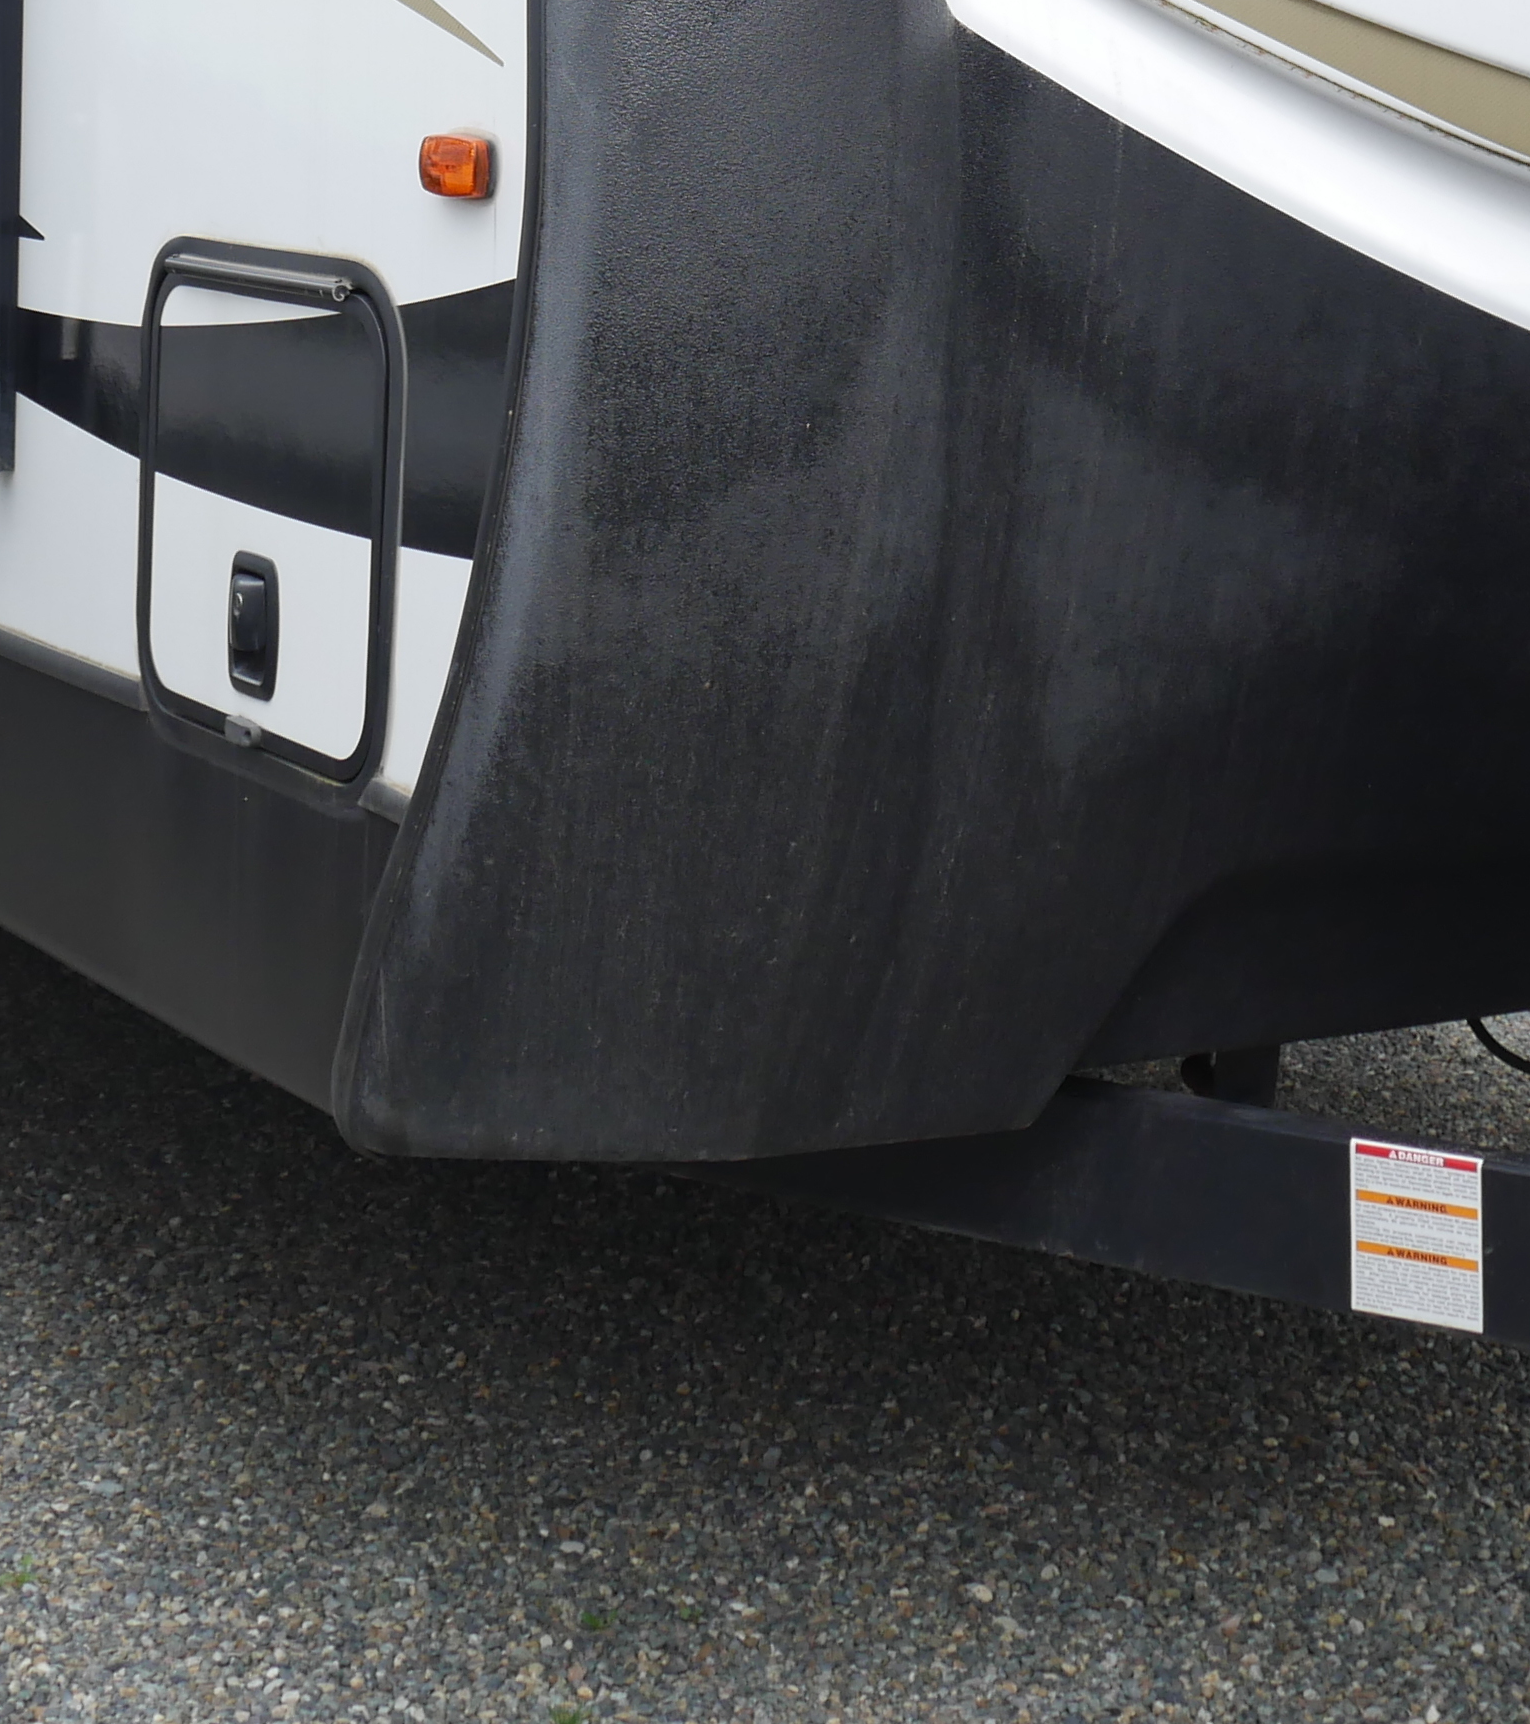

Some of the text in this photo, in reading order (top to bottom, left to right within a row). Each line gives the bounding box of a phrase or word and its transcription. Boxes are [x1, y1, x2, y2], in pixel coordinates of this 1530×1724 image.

[1397, 1150, 1445, 1167] DANGER
[1396, 1197, 1448, 1214] WARNING
[1396, 1249, 1448, 1266] WARNING
